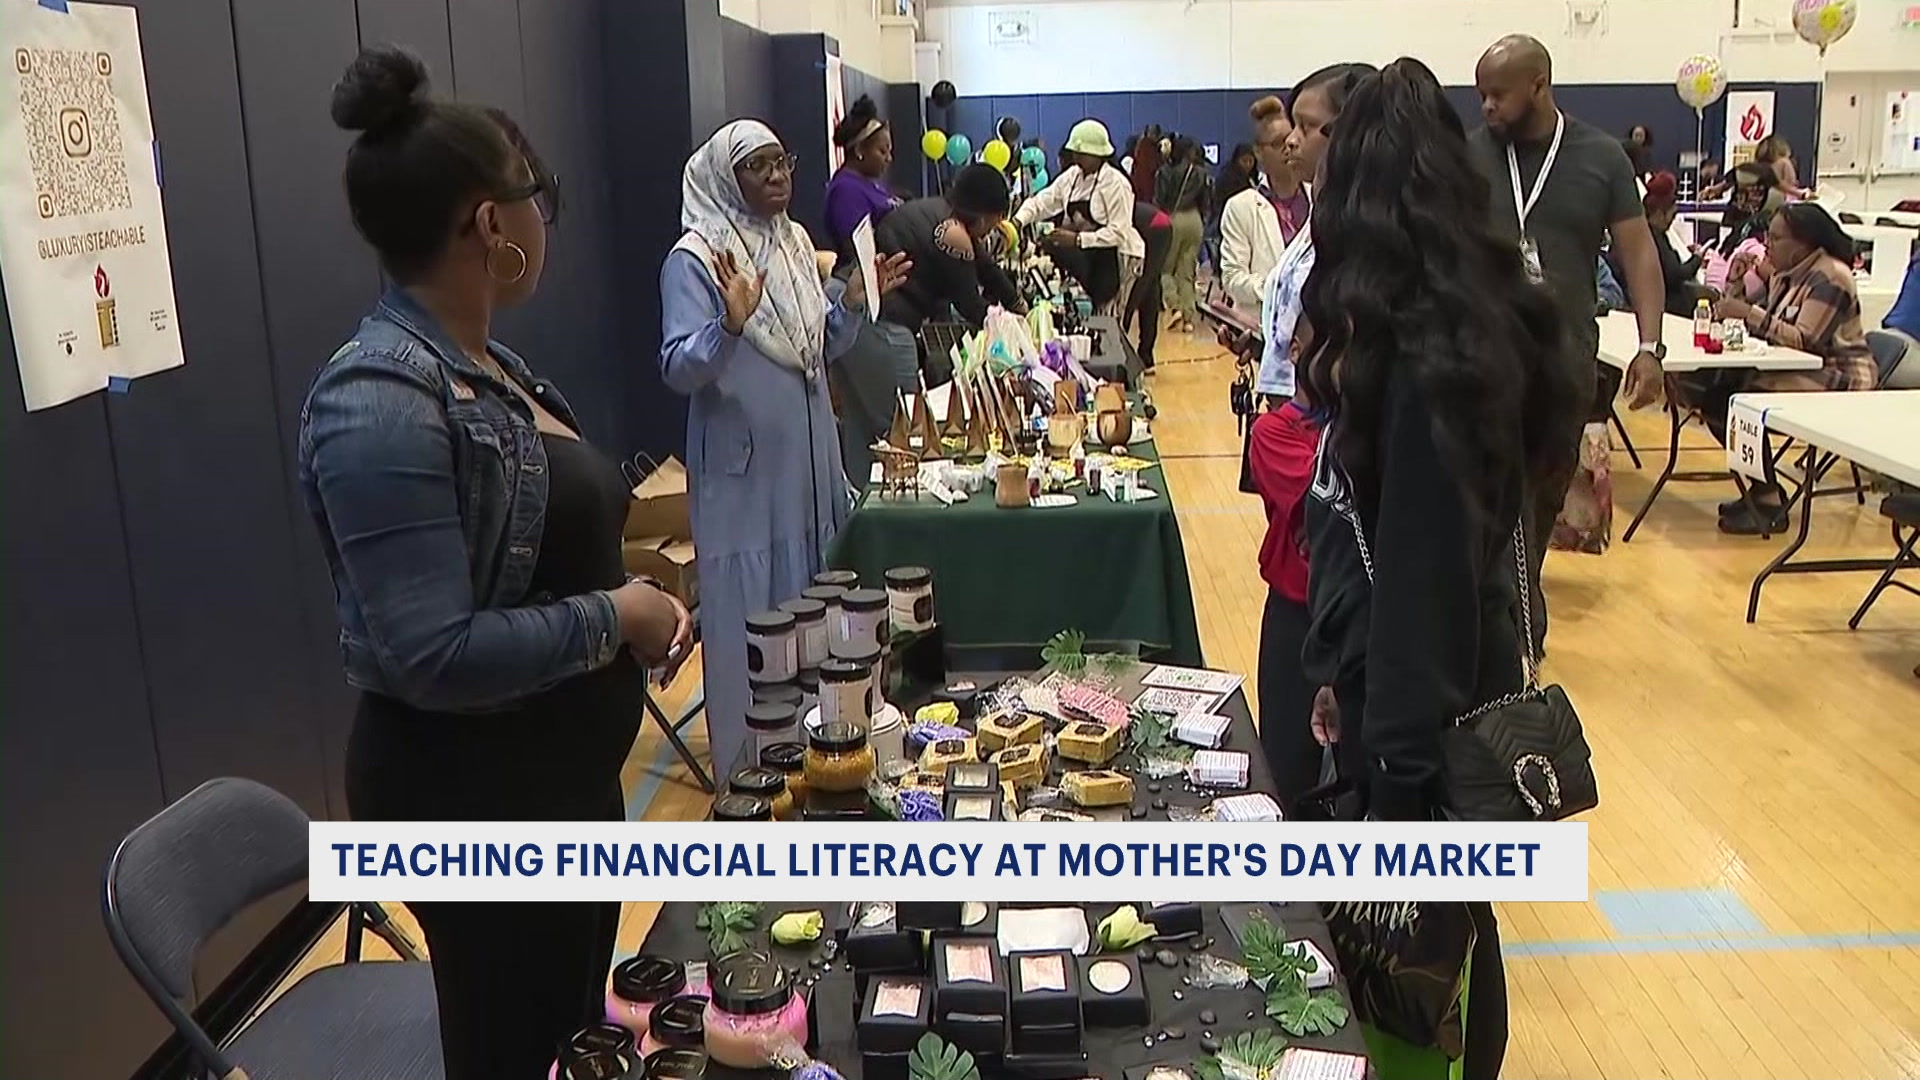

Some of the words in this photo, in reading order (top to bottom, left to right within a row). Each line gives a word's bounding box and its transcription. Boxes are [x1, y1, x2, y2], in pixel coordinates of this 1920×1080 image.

[38, 226, 146, 259] @LUXURYISTEACHABLE
[1740, 419, 1759, 438] TABLE
[1741, 443, 1755, 466] 59
